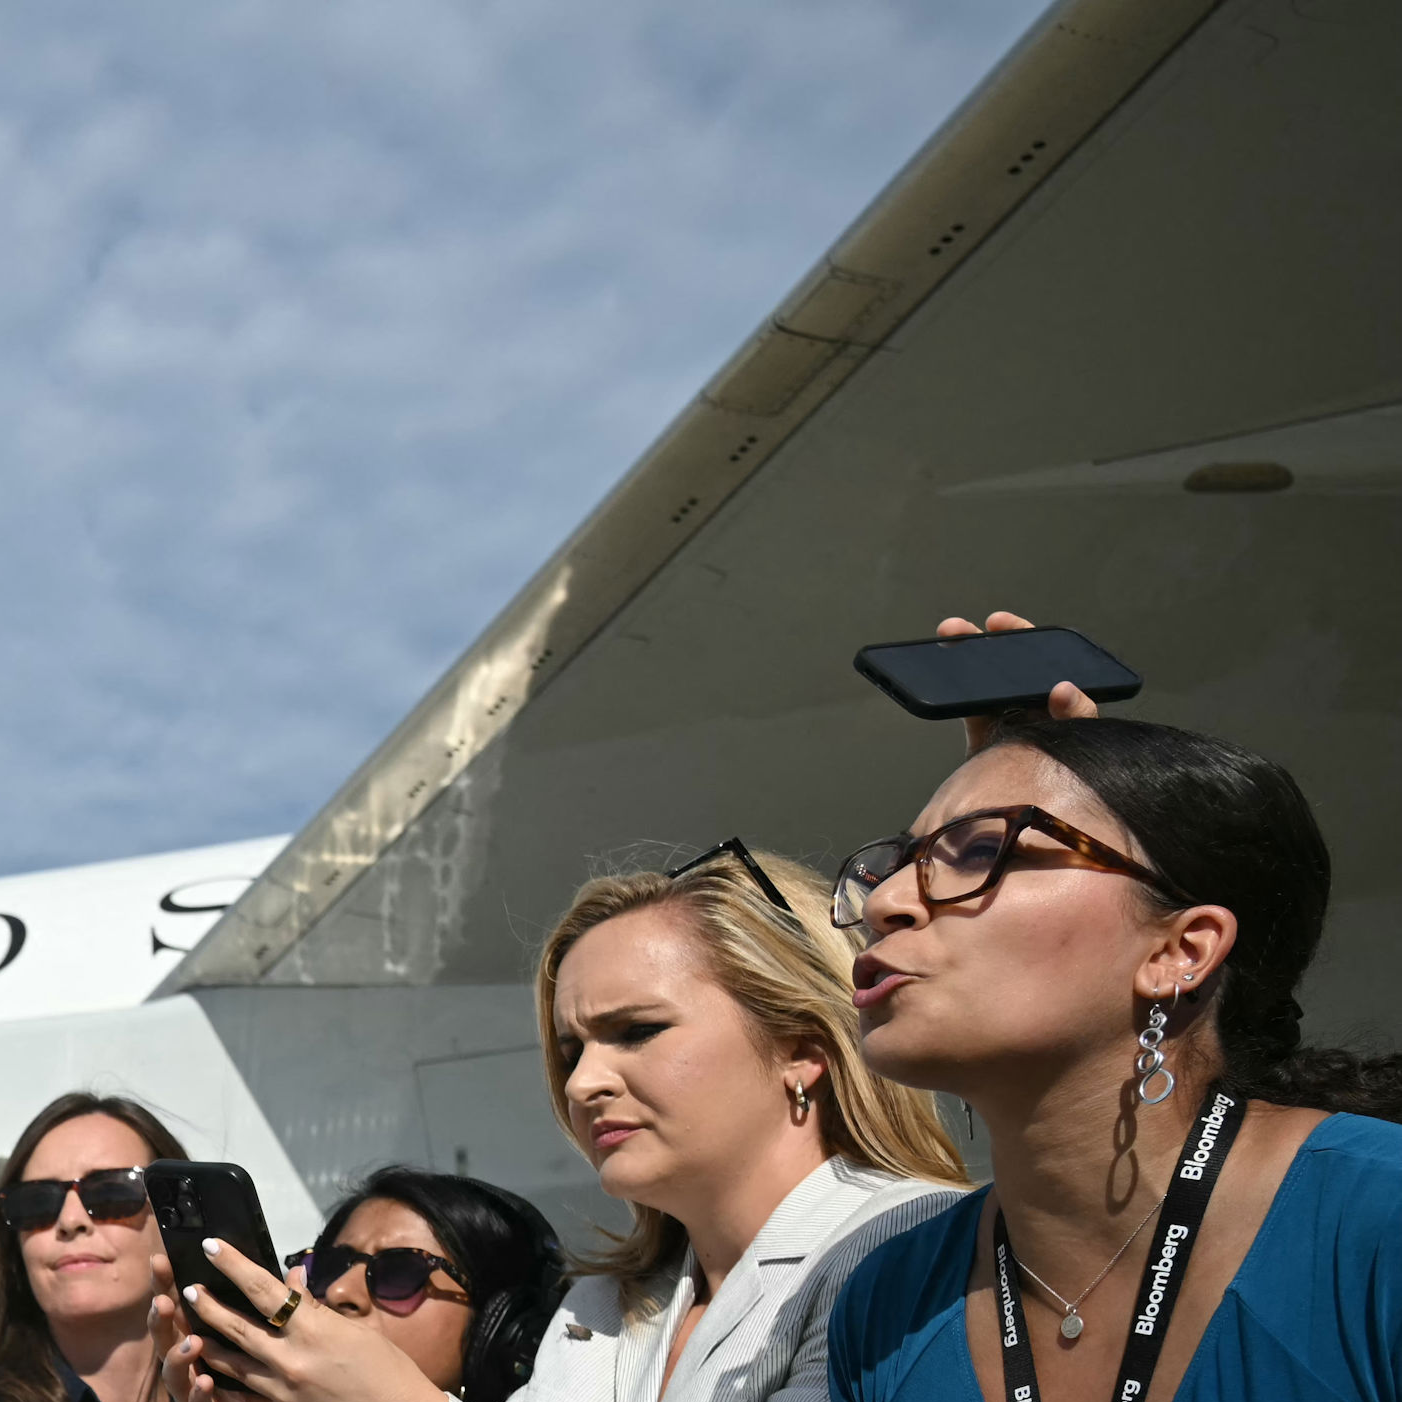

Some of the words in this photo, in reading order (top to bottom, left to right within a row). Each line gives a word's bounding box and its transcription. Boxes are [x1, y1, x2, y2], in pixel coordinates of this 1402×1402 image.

[1179, 1092, 1235, 1181] Bloomberg
[997, 1244, 1019, 1348] Bloomberg
[1134, 1223, 1189, 1336] Bloomberg
